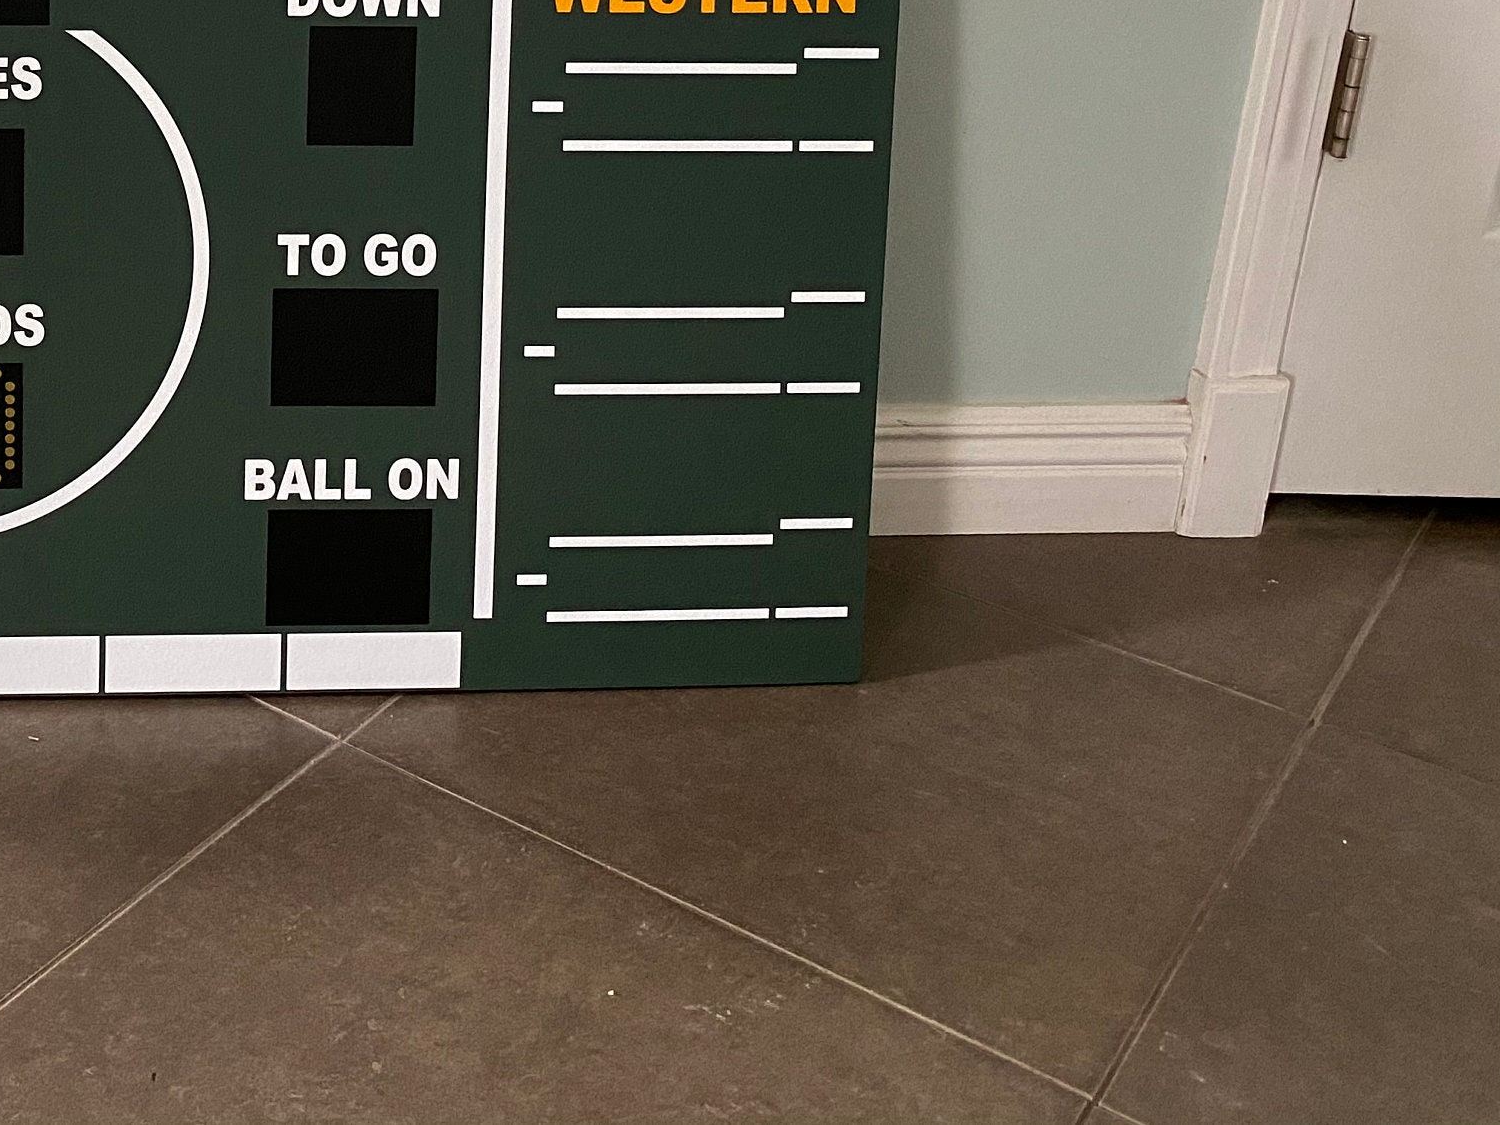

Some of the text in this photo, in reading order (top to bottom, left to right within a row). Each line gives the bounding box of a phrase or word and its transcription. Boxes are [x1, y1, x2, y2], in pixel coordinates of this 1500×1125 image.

[277, 232, 437, 277] TO GO
[243, 458, 460, 501] BALL ON
